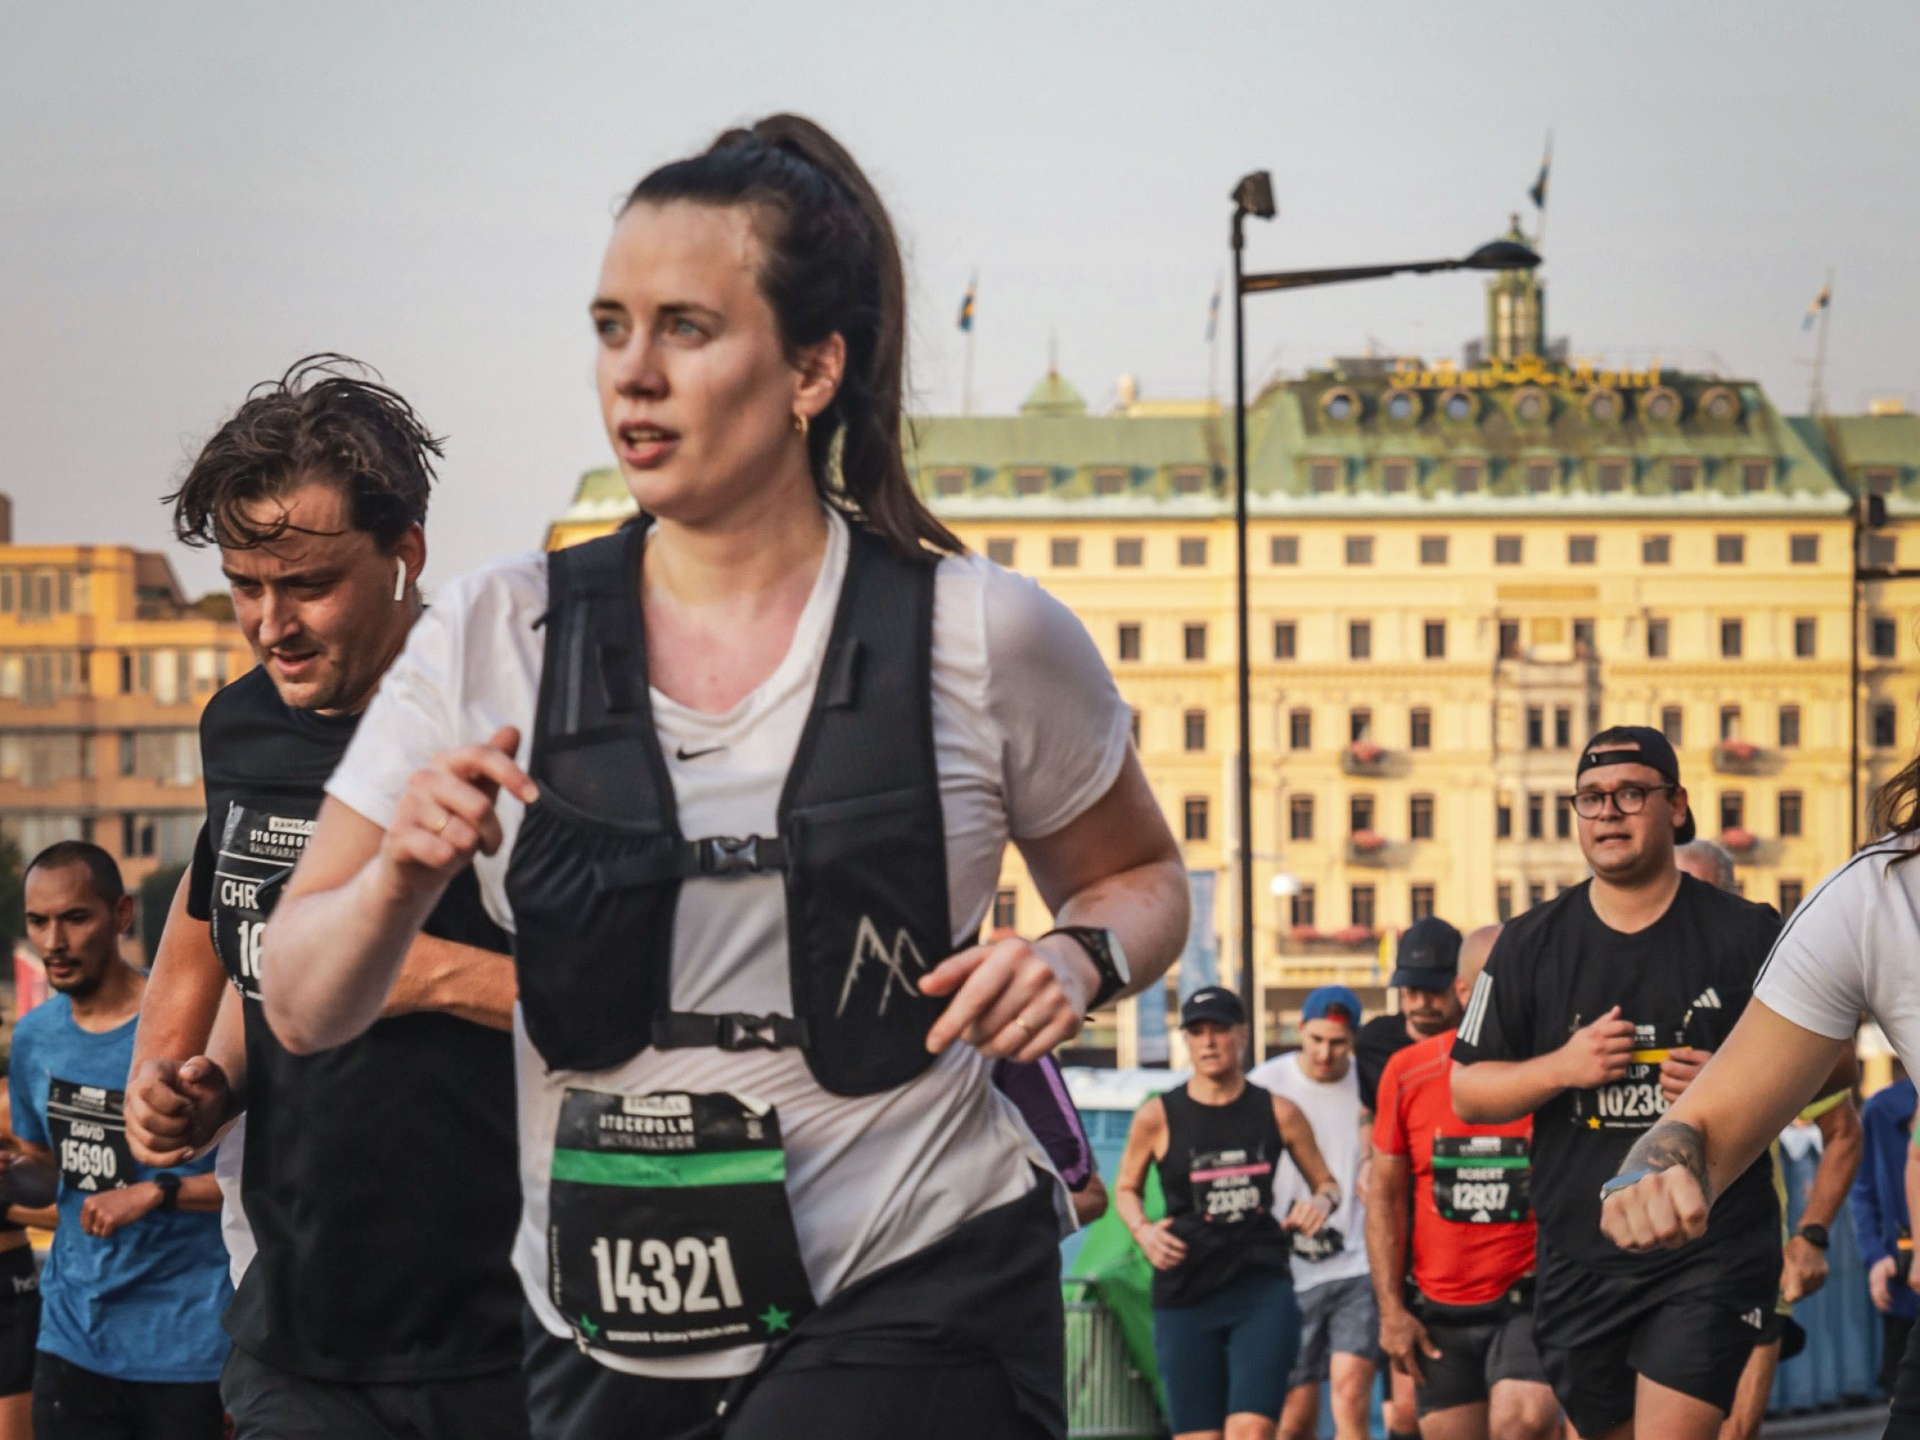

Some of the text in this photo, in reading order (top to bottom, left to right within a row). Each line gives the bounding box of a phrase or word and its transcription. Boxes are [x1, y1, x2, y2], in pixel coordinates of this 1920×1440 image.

[1596, 1083, 1671, 1118] 10238
[60, 1138, 117, 1179] 15690
[1452, 1182, 1511, 1211] 12937
[591, 1235, 744, 1315] 14321
